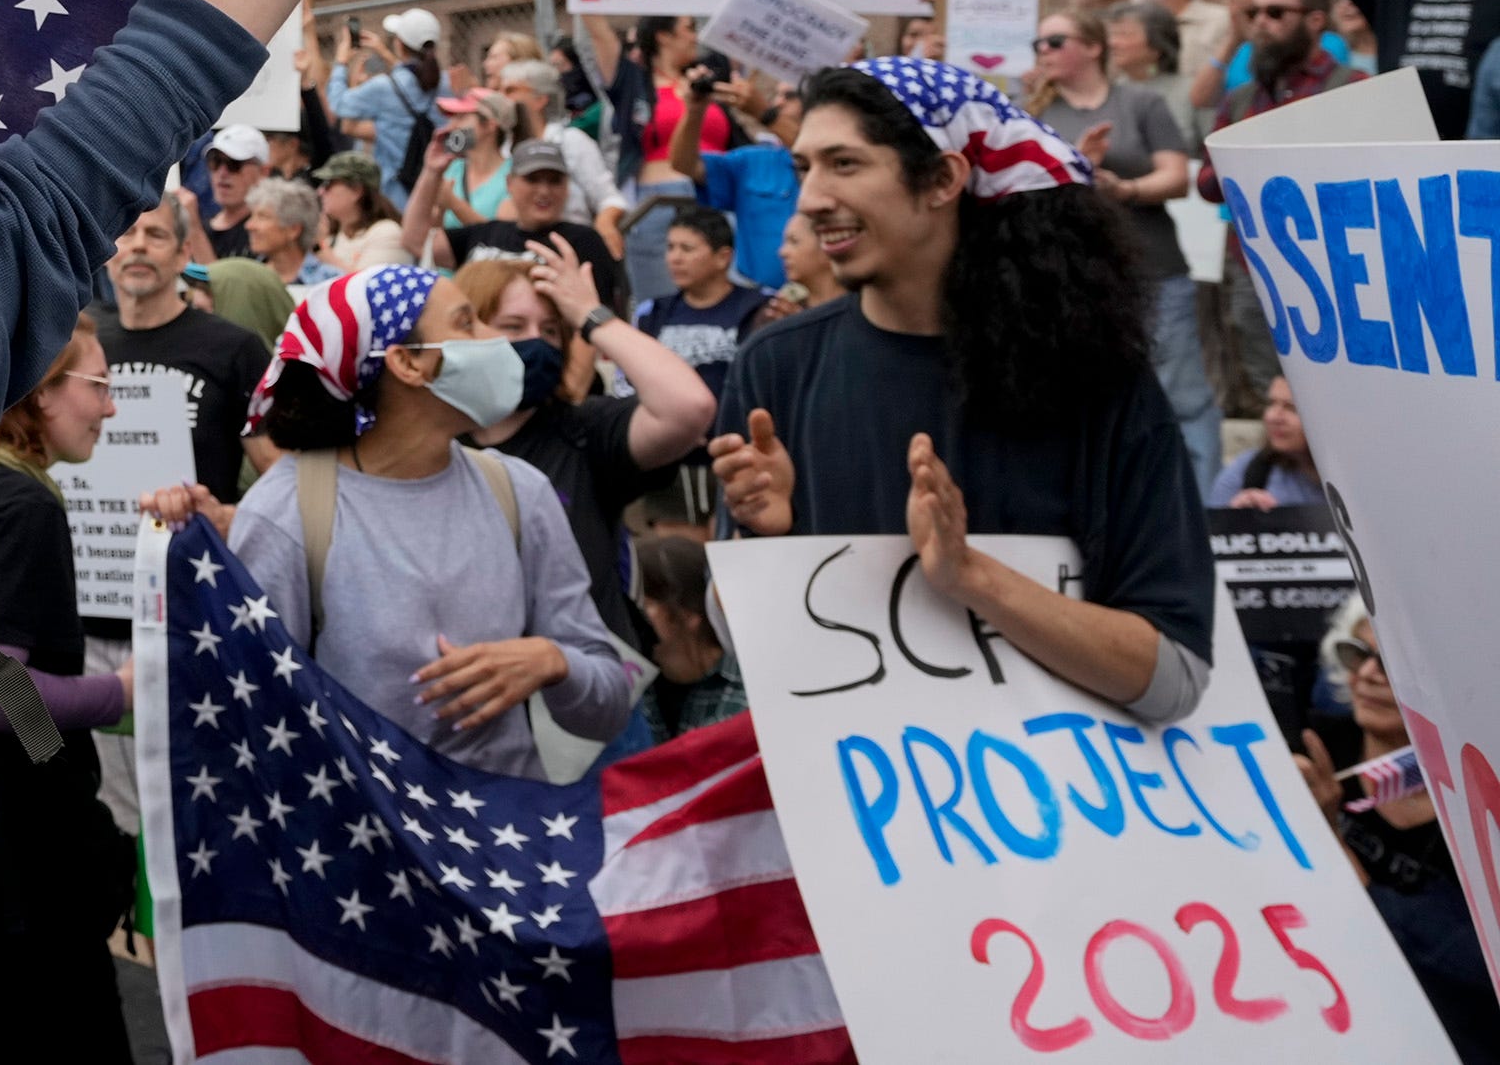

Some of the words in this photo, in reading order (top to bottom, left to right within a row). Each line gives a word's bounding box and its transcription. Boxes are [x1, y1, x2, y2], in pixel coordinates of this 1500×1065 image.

[107, 431, 160, 445] RIGHTS
[66, 500, 94, 512] DER
[99, 500, 127, 513] THE
[1210, 533, 1257, 554] LIC
[1258, 531, 1346, 553] DOLLA
[95, 570, 134, 583] nation
[1270, 586, 1353, 609] SCHOO
[837, 712, 1315, 887] PROJECT
[969, 900, 1353, 1053] 2025
